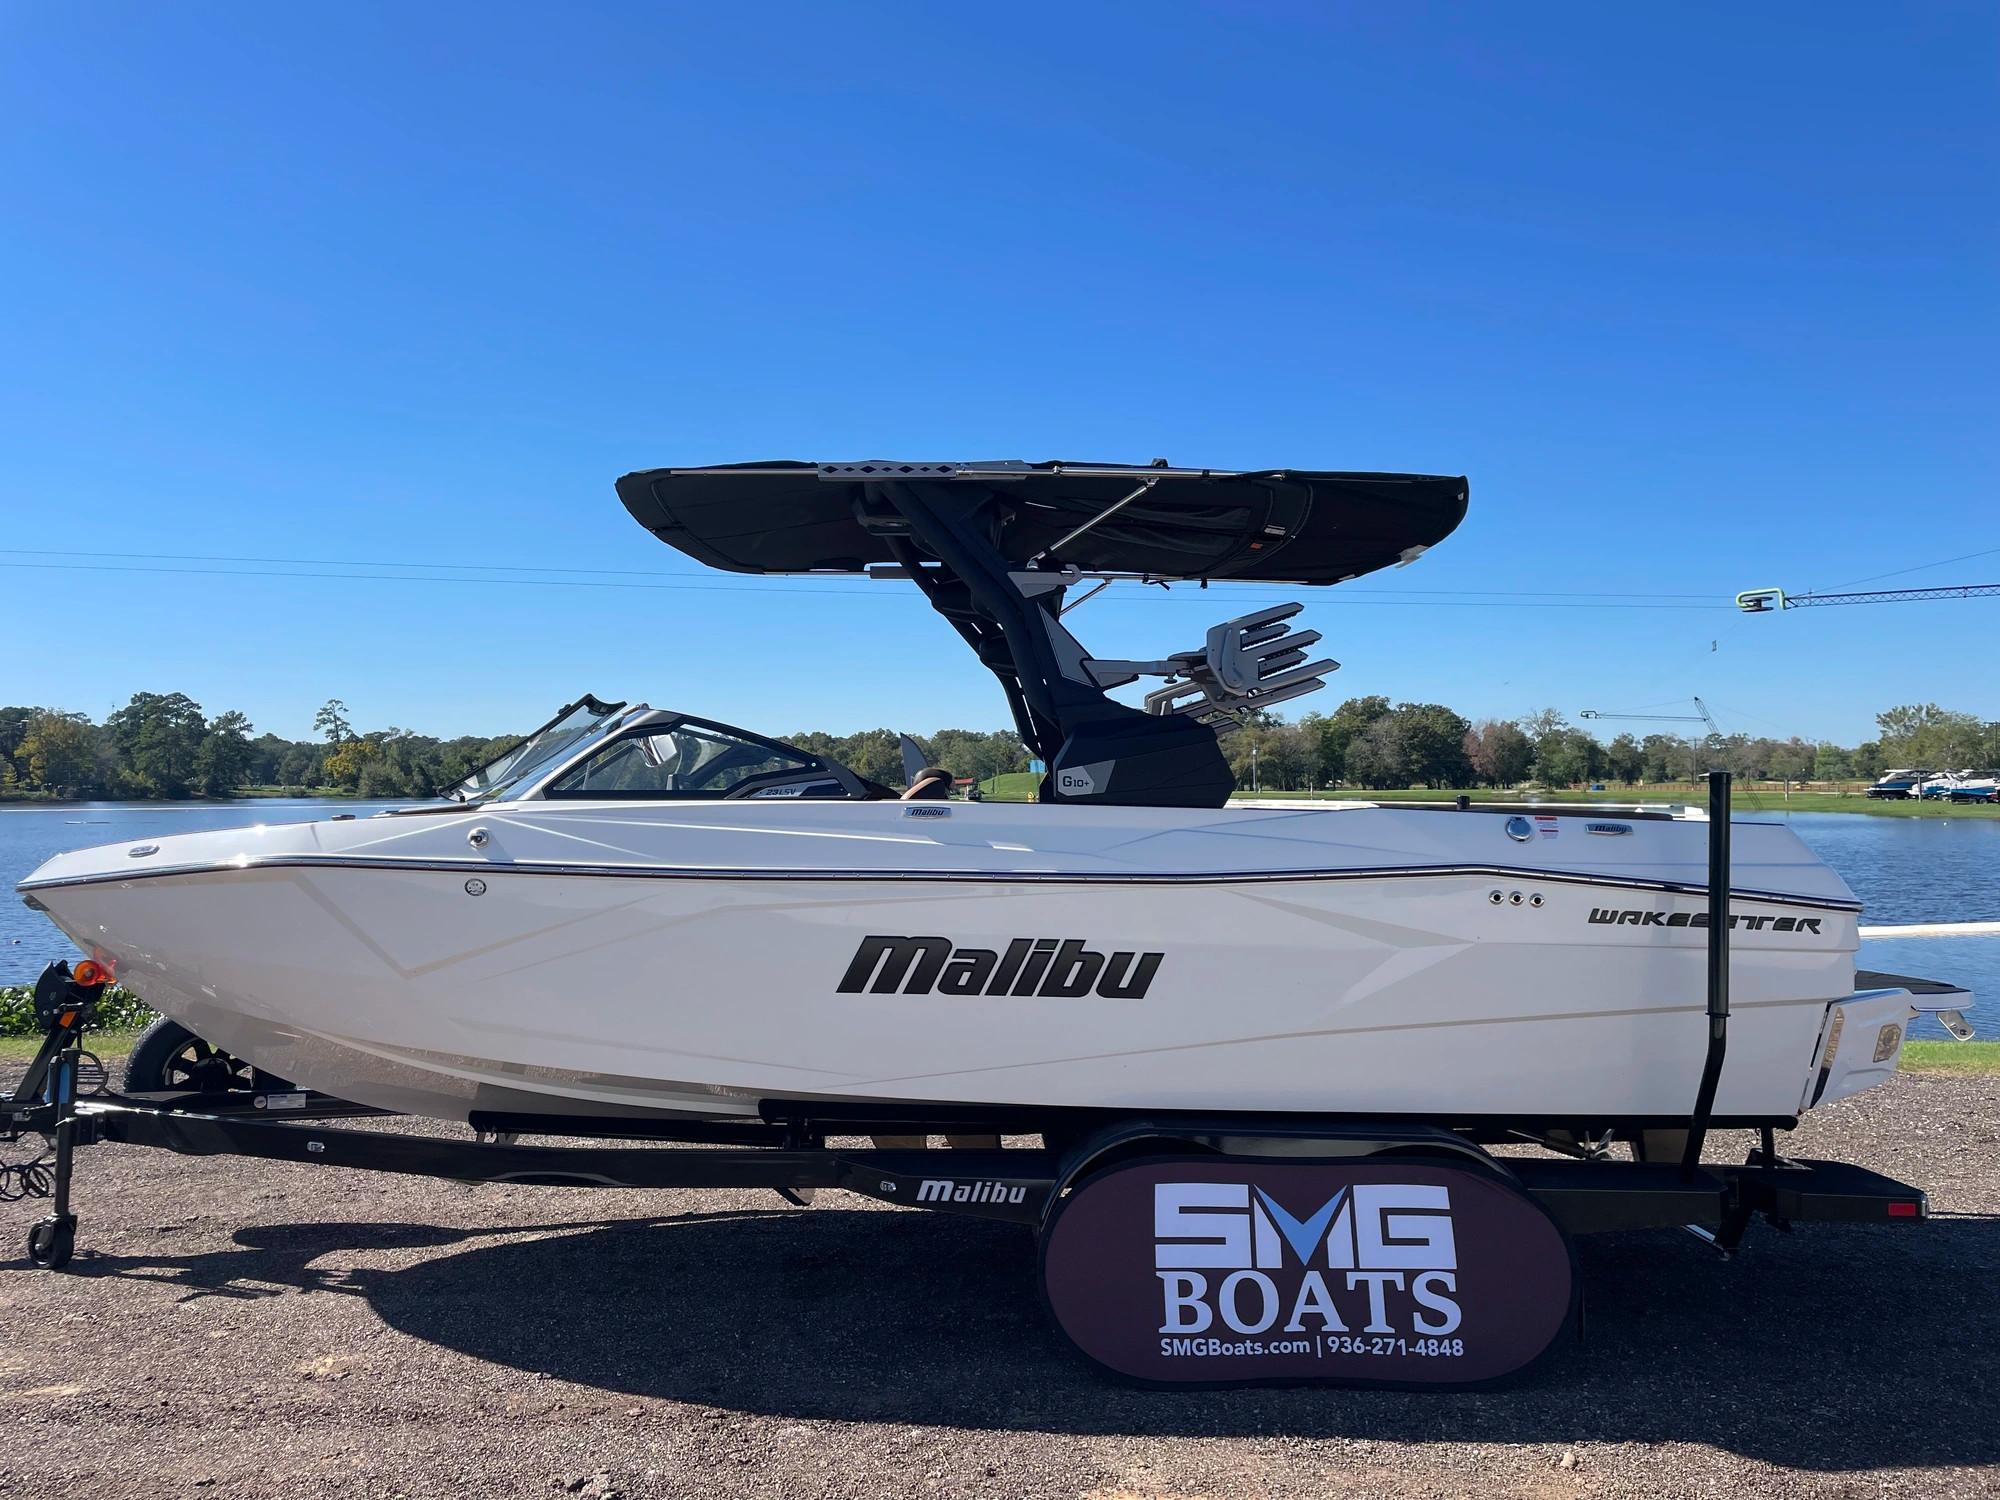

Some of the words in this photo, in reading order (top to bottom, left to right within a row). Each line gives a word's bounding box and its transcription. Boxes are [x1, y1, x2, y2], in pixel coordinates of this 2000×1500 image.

[911, 808, 945, 816] Malibu
[835, 935, 1165, 1000] Malibu
[916, 1180, 1026, 1204] Malibu
[1154, 1183, 1457, 1270] SMG
[1155, 1270, 1463, 1336] BOATS
[1160, 1337, 1311, 1356] SMGBoats.com
[1327, 1335, 1464, 1357] 936-271-4848
